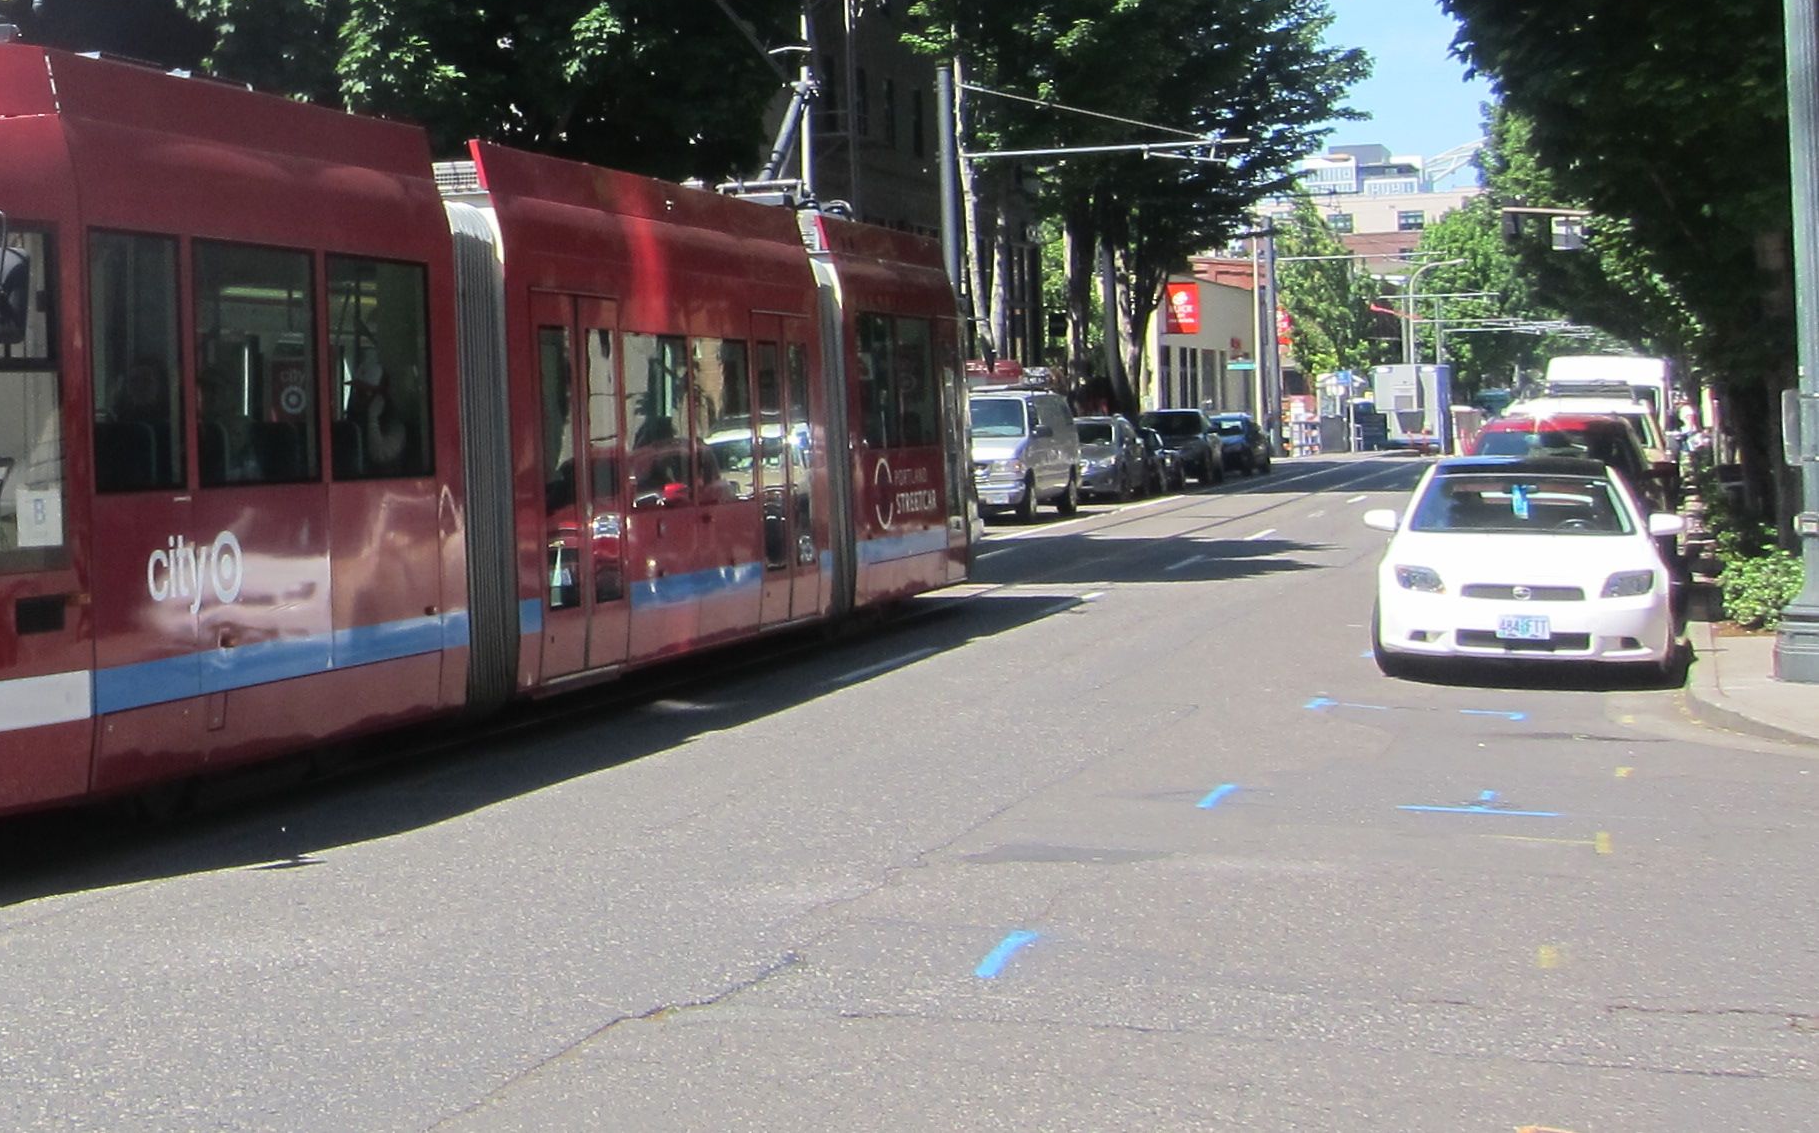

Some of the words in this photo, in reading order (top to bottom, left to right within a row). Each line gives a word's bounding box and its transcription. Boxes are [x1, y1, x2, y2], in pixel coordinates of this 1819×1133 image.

[280, 368, 306, 384] city
[893, 467, 927, 485] PORTLAND
[895, 489, 937, 514] STREETCAR
[147, 534, 207, 615] city
